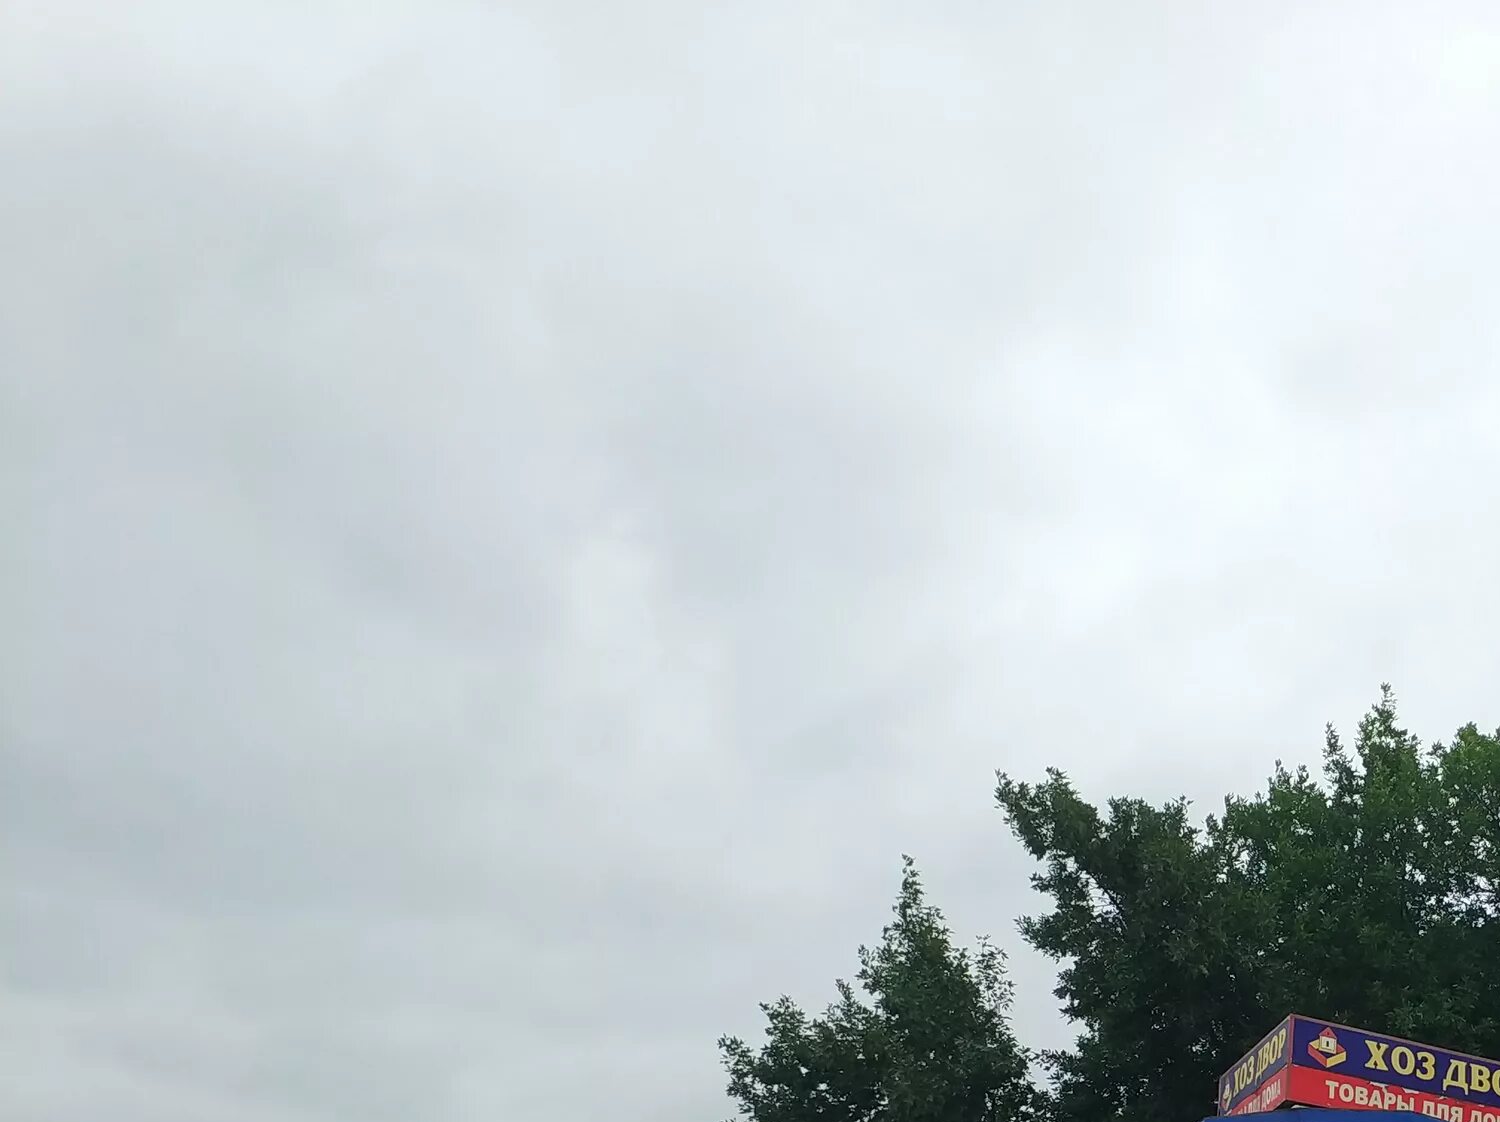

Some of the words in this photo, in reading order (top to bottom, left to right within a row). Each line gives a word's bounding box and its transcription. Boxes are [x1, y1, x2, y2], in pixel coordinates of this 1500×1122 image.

[1233, 1056, 1254, 1097] ХОЗ
[1255, 1028, 1286, 1085] ДВОР
[1365, 1040, 1436, 1080] ХОЗ
[1261, 1078, 1280, 1112] ДОМА
[1325, 1080, 1414, 1111] ТОВАРЫ
